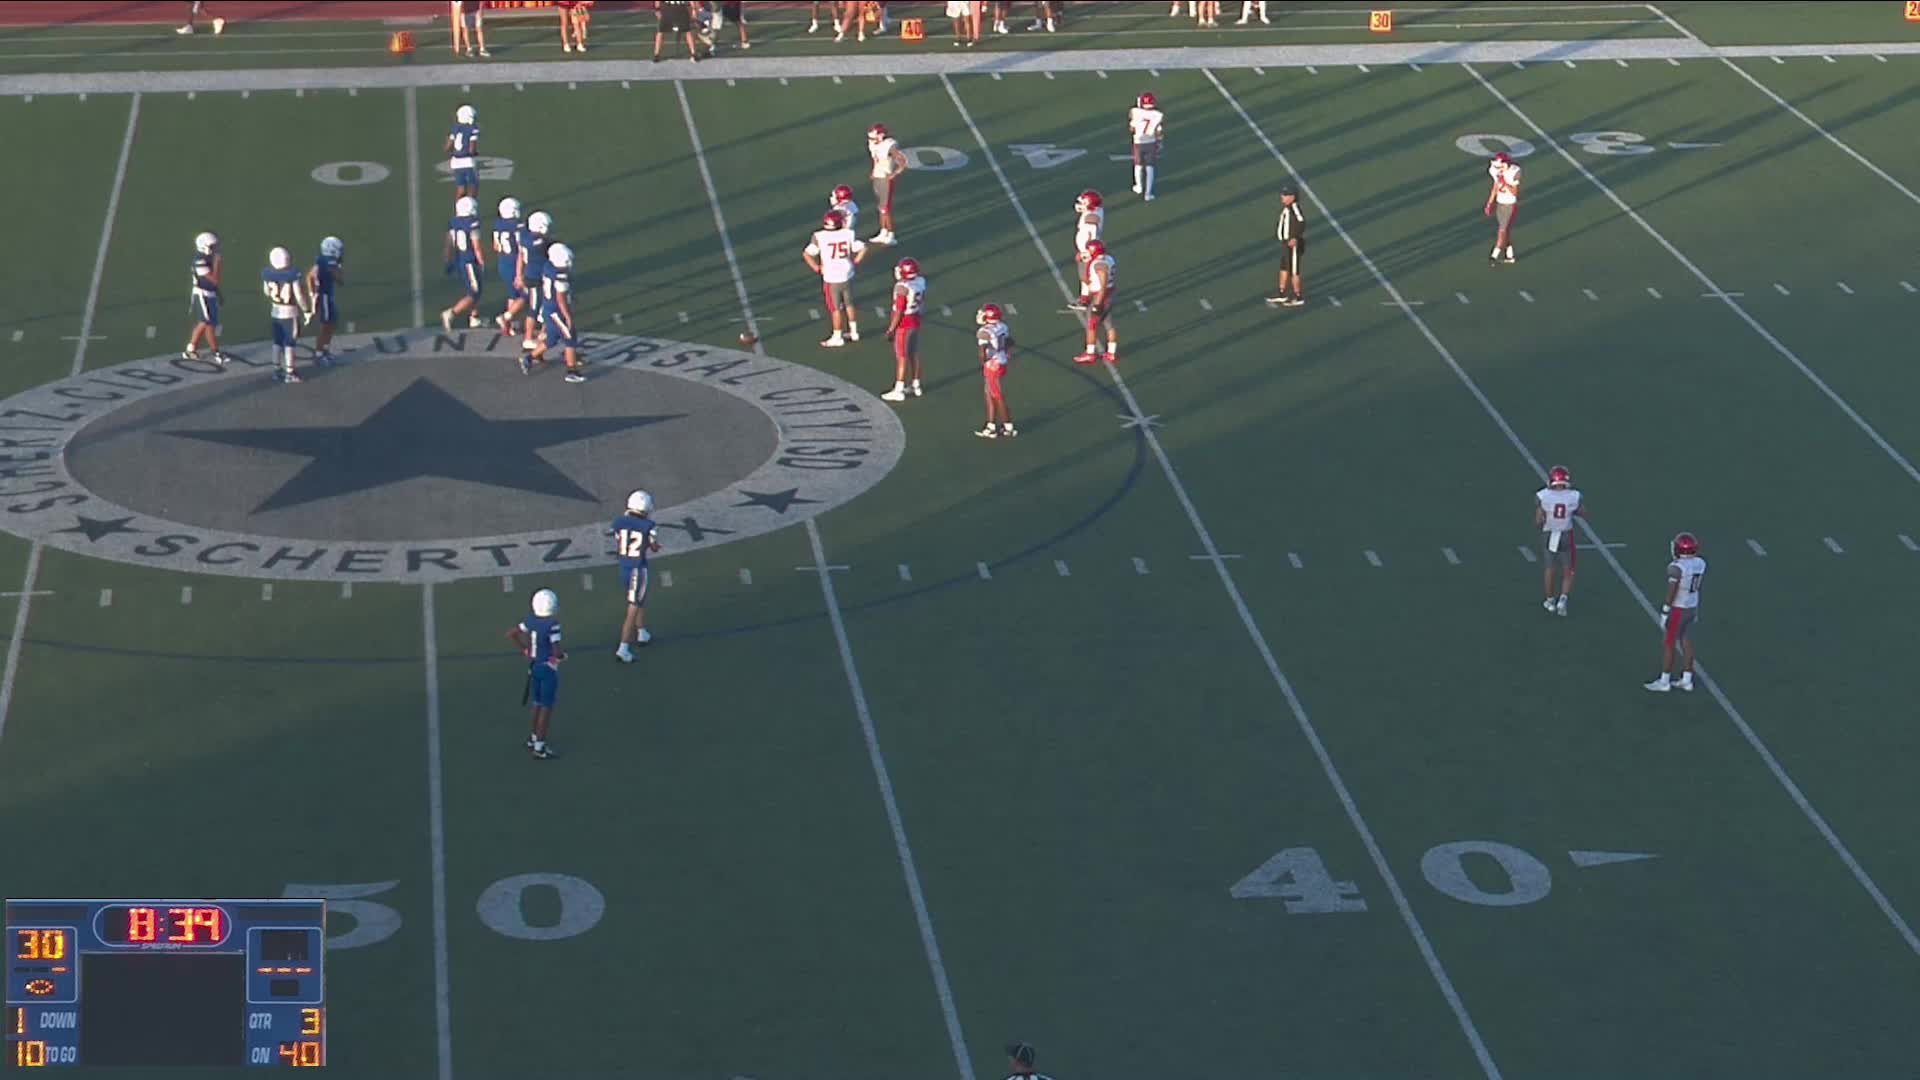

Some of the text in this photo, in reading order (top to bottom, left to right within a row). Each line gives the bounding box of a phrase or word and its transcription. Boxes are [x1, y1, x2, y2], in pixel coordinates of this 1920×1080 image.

[1374, 13, 1389, 28] 30
[1143, 119, 1151, 134] 7
[828, 242, 848, 260] 75
[268, 280, 292, 304] 24
[759, 386, 873, 429] CITY
[775, 438, 873, 470] ISD
[1553, 503, 1566, 519] 0
[134, 533, 592, 574] SCHERTZ
[619, 528, 643, 557] 12
[531, 630, 537, 658] 1
[1230, 840, 1552, 914] 40
